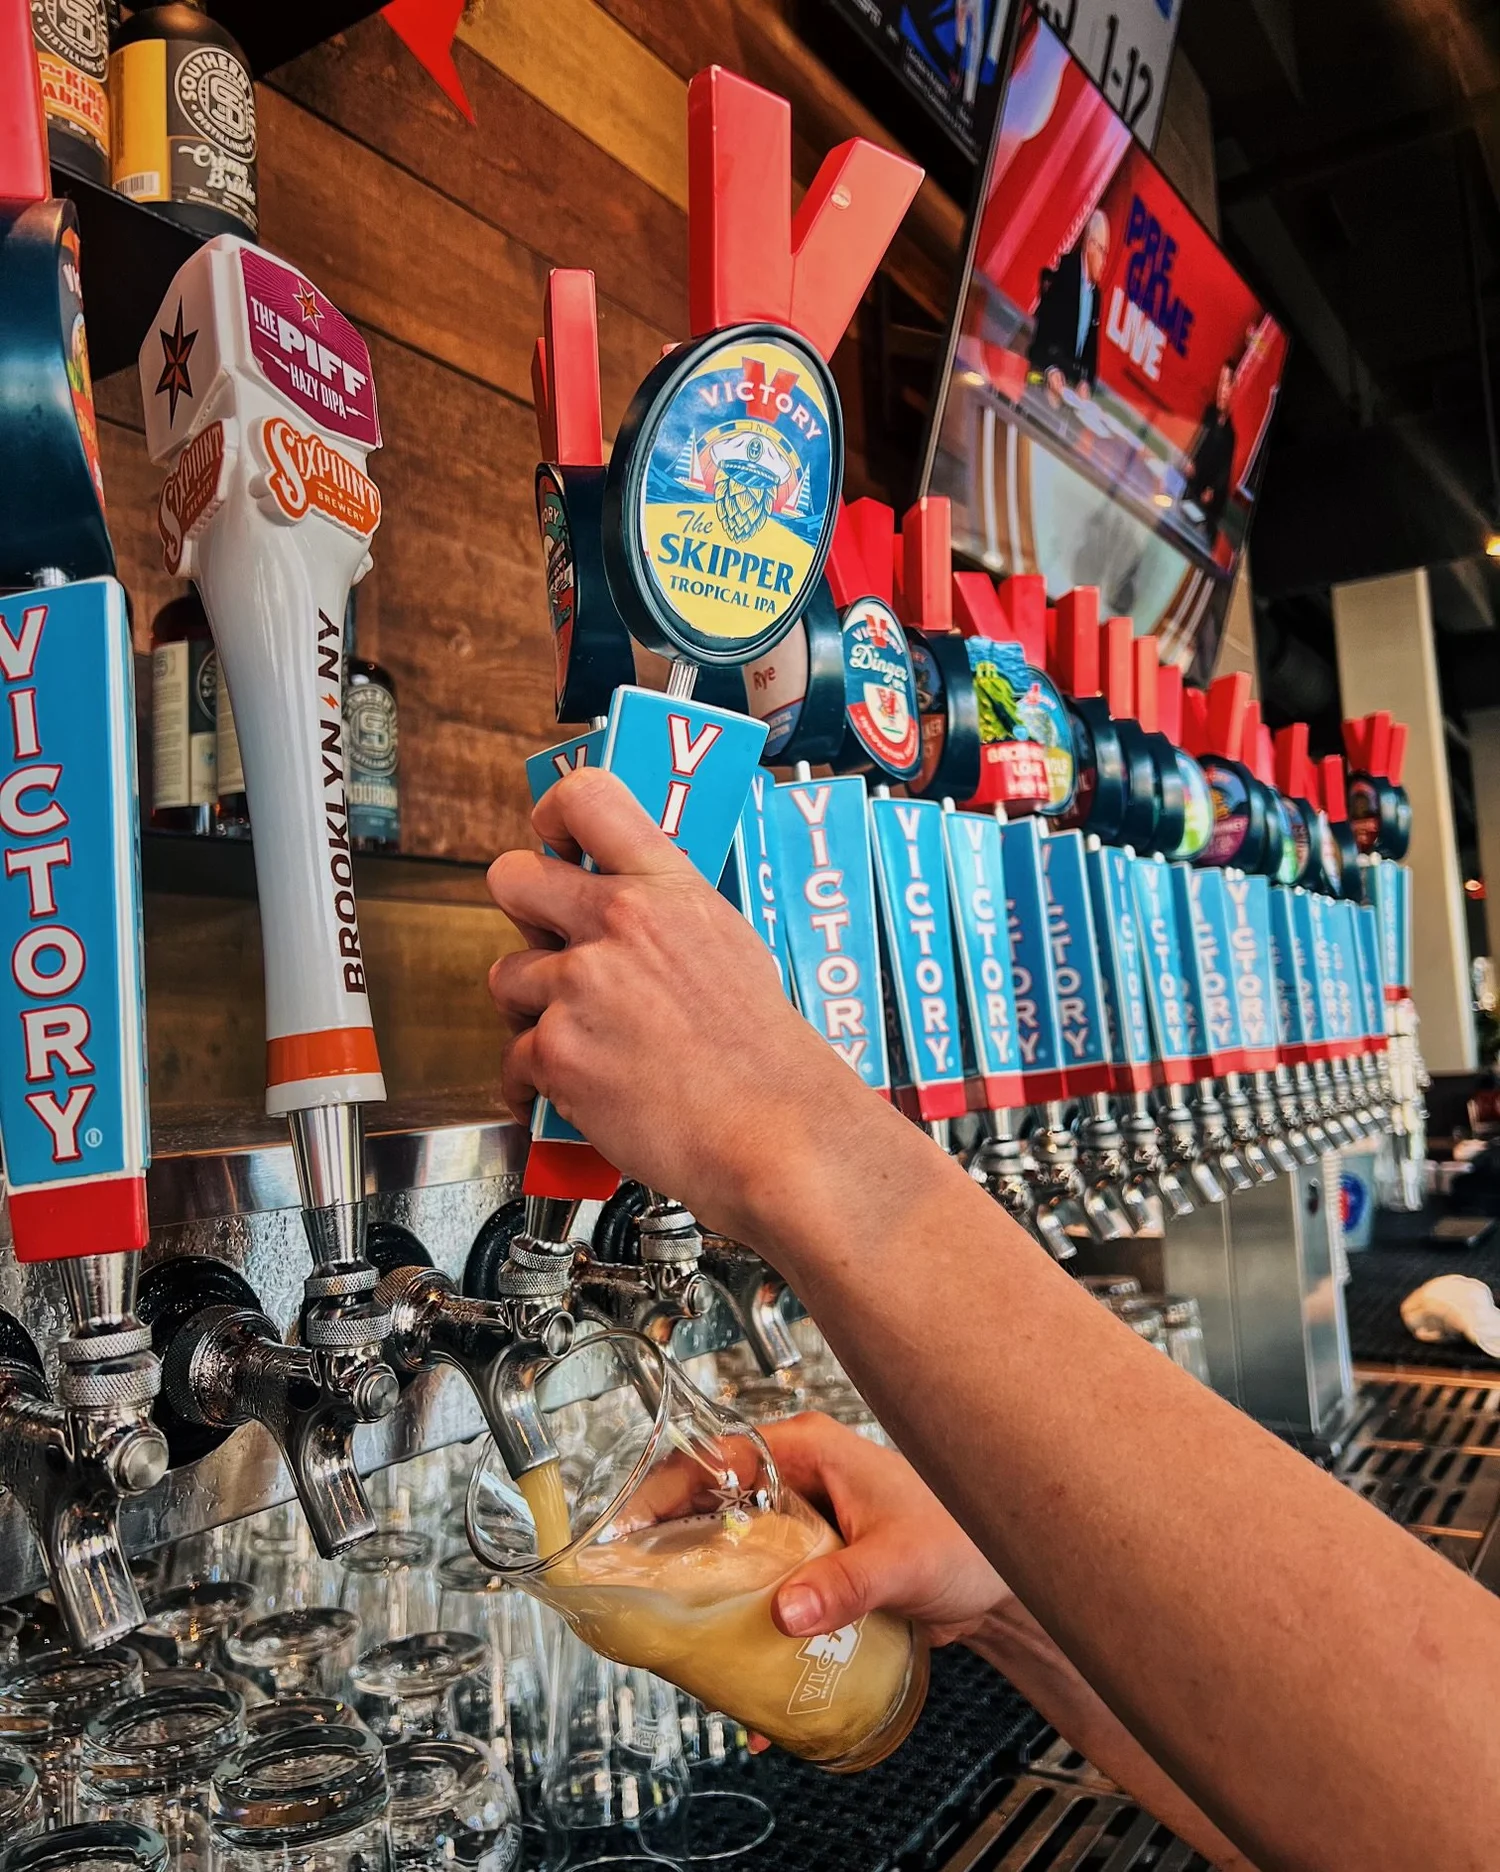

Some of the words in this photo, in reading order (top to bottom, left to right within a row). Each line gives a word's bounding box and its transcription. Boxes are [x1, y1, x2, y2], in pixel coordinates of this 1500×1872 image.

[180, 52, 249, 101] SOUTHERN
[1127, 194, 1178, 273] PRE
[1105, 285, 1168, 382] LIVE
[1127, 250, 1195, 359] GAME
[250, 296, 278, 336] THE
[277, 314, 368, 398] PIFF
[289, 362, 320, 402] HAZY
[320, 382, 348, 421] DIPA
[699, 380, 823, 441] VICTORY
[271, 421, 380, 517] SIXPOINT
[317, 490, 366, 525] BREWERY
[676, 509, 715, 534] The
[657, 532, 795, 596] SKIPPER
[669, 574, 750, 608] TROPICAL
[753, 595, 777, 615] IPA
[317, 607, 341, 684] NY
[753, 666, 777, 691] Rye
[849, 643, 909, 684] Dinger
[851, 626, 904, 656] VICTORY
[0, 603, 96, 1166] VICTORY
[320, 719, 367, 995] BROOKLYN
[894, 806, 950, 1074] VICTORY
[963, 819, 1010, 1064] VICTORY
[1114, 855, 1148, 1056] VICTORY
[1143, 866, 1182, 1053] VICTORY
[1226, 879, 1267, 1046] VICTORY
